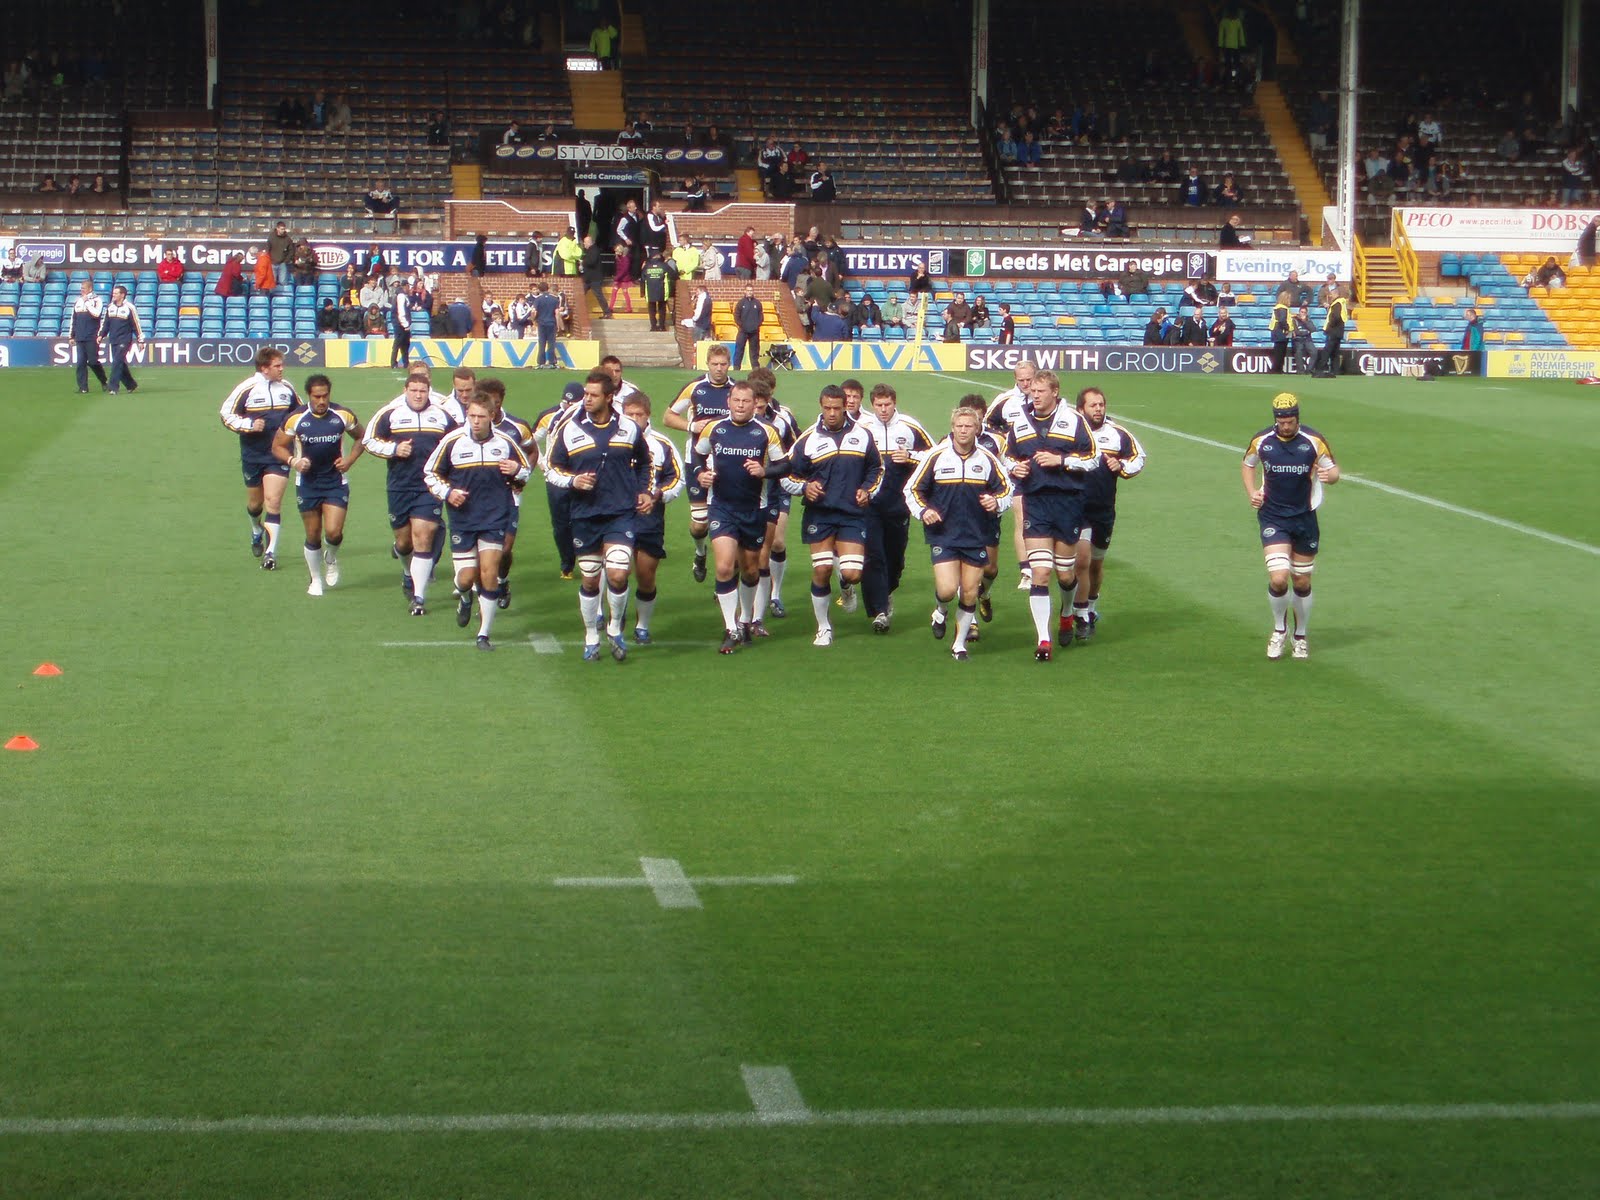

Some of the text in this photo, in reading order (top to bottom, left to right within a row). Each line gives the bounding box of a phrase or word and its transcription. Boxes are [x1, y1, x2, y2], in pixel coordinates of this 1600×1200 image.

[560, 146, 625, 159] STVDIO
[574, 172, 633, 182] Leeds Carnegie
[1406, 213, 1453, 227] PECO
[1531, 213, 1594, 231] DOBS
[28, 248, 63, 259] cnegie
[69, 243, 258, 265] Leeds Mt Carne
[353, 249, 552, 266] TE FOR A ETLES
[845, 253, 922, 270] TETLEY'S
[990, 252, 1183, 275] Leeds Met Carnegie
[1226, 257, 1343, 277] Evening Post
[197, 343, 290, 363] GROP
[398, 340, 576, 368] AVIVA
[1531, 352, 1566, 361] AVIVA
[1105, 351, 1194, 372] GROUP
[1232, 352, 1311, 373] GUINE
[1359, 354, 1444, 374] GUIN
[1531, 361, 1595, 370] PREMIERSHIP
[1531, 370, 1565, 378] RUGBY
[704, 407, 731, 416] carne
[308, 432, 340, 444] carnegi
[722, 447, 761, 458] carnegie
[1271, 463, 1310, 475] carnegie
